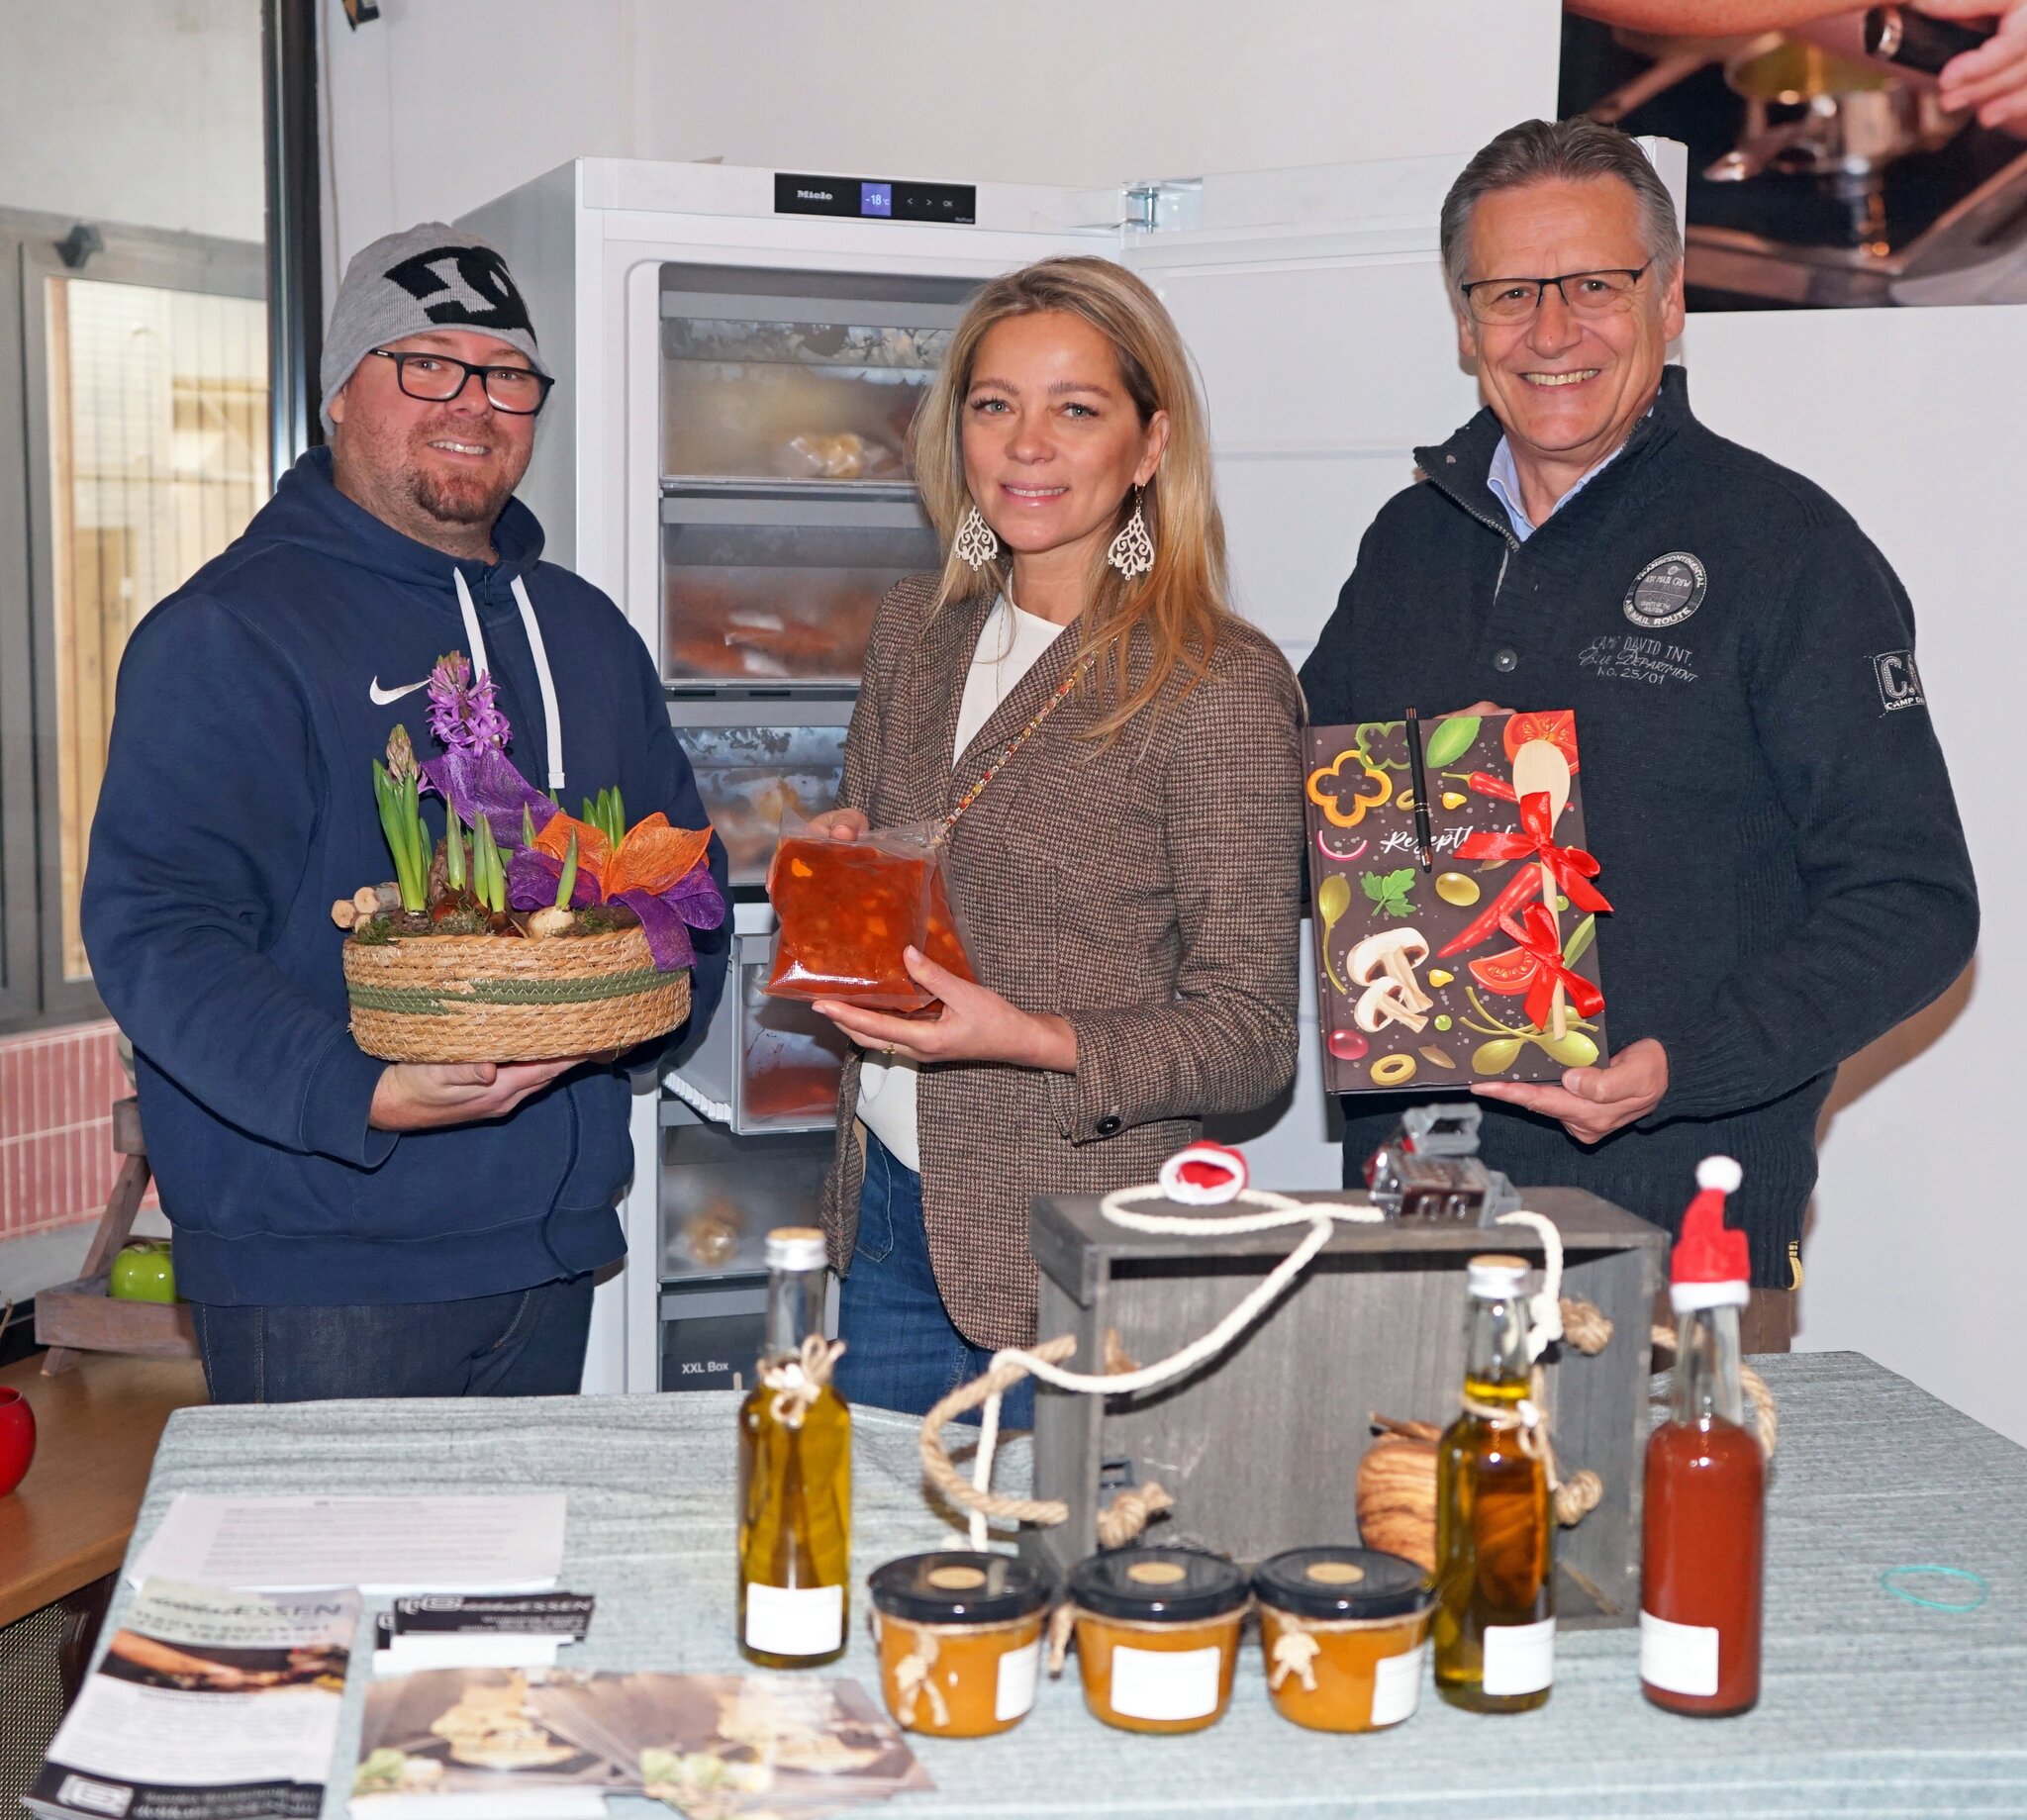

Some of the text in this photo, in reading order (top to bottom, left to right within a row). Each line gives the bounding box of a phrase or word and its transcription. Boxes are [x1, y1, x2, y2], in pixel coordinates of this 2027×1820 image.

[797, 189, 833, 201] Miele
[1653, 606, 1692, 625] ROUTE
[1623, 636, 1663, 655] DAVID
[1615, 648, 1699, 683] DEPARTMENT
[1885, 696, 1915, 710] CAMP
[682, 1360, 729, 1375] XXL Box
